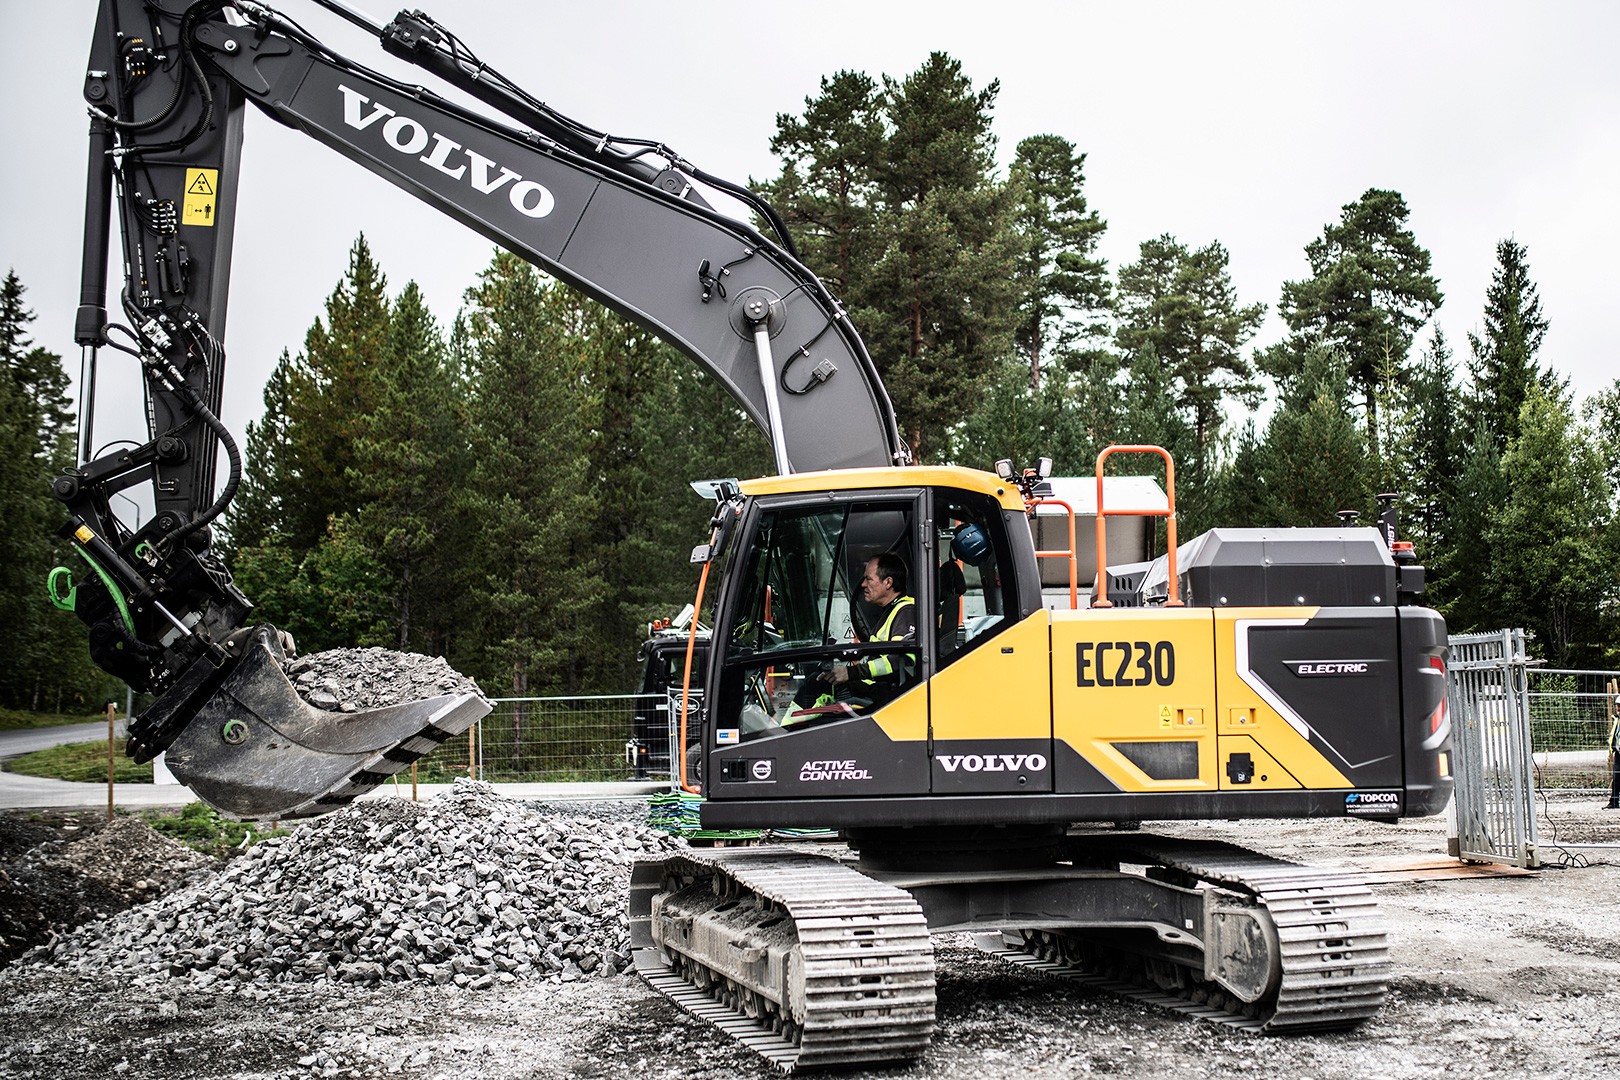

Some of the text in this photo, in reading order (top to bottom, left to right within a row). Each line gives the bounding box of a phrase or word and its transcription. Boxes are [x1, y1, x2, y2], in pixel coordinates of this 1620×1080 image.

[338, 84, 555, 218] VOLVO
[1076, 641, 1175, 687] EC230
[1298, 664, 1368, 674] ELECTRIC
[801, 760, 857, 771] ACTIVE
[936, 754, 1047, 772] VOLVO
[800, 770, 873, 781] CONTROL
[1359, 793, 1398, 803] TOPCON
